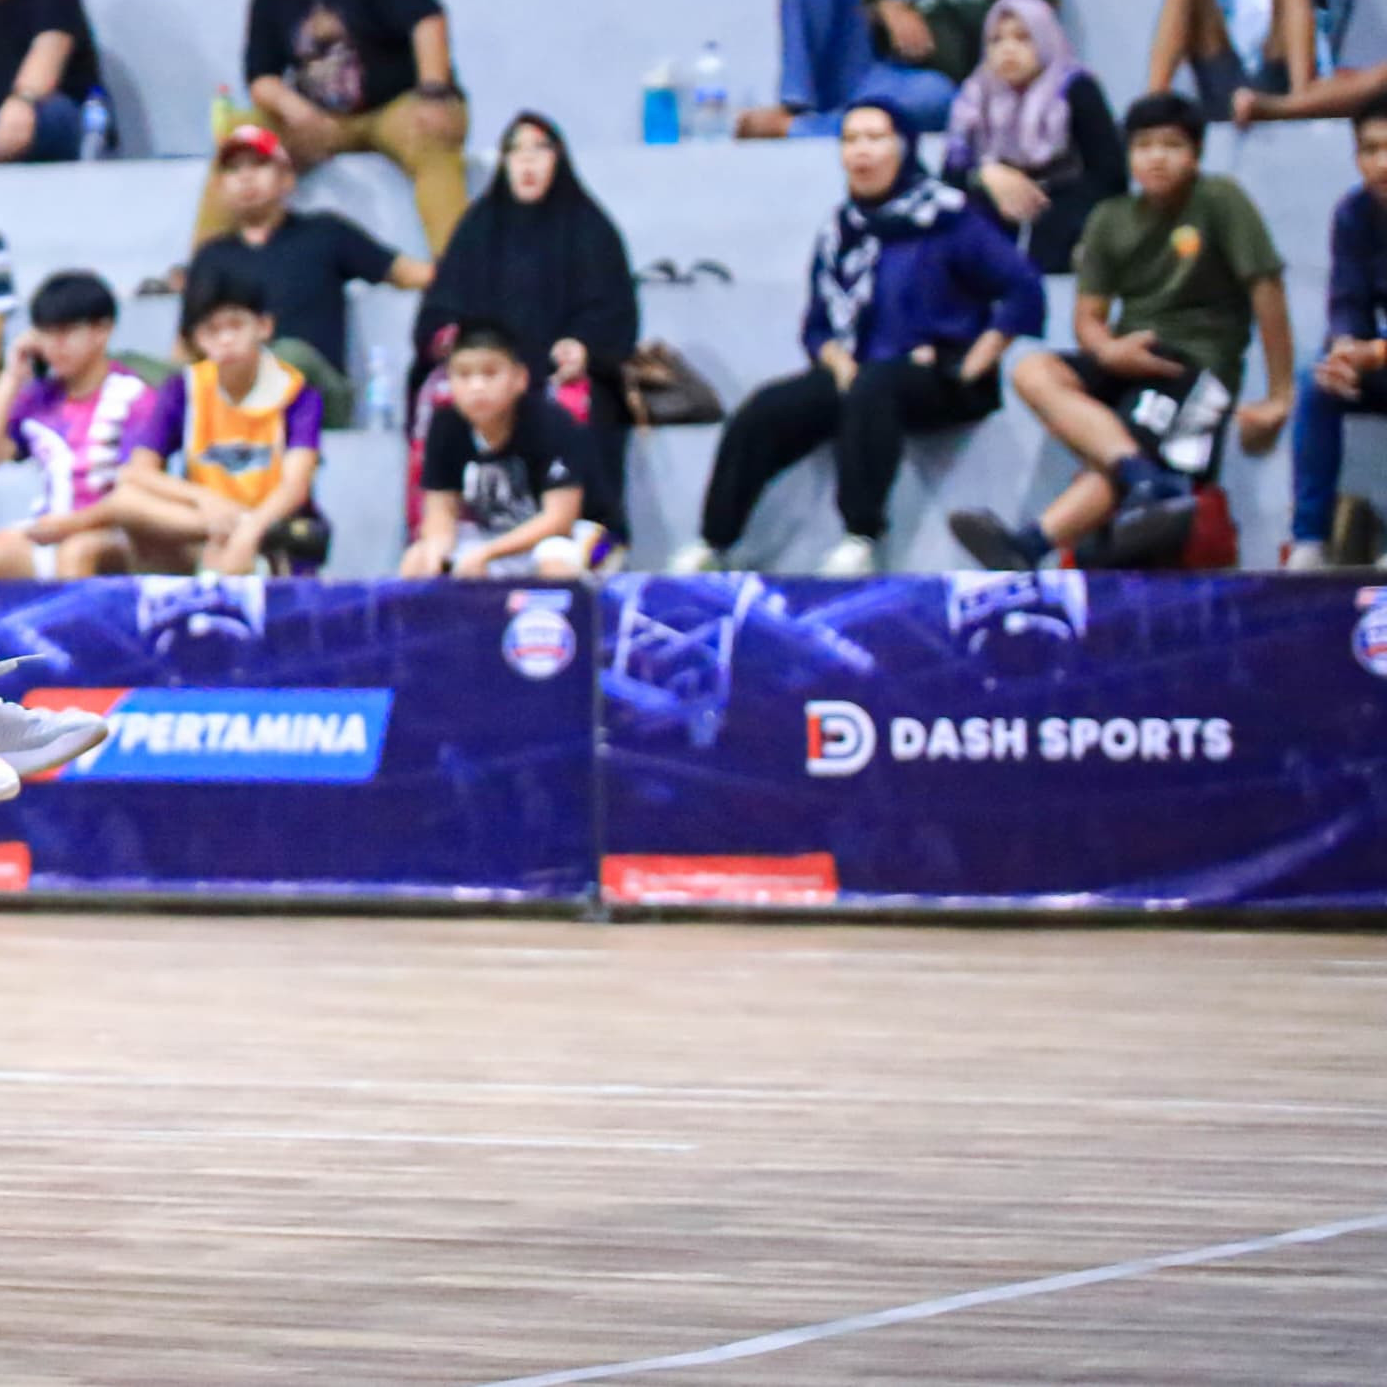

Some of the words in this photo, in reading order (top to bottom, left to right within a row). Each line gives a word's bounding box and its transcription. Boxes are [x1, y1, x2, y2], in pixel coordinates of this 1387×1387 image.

[118, 712, 368, 753] PERTAMINA
[890, 717, 1027, 760] DASH
[1039, 717, 1233, 761] SPORTS
